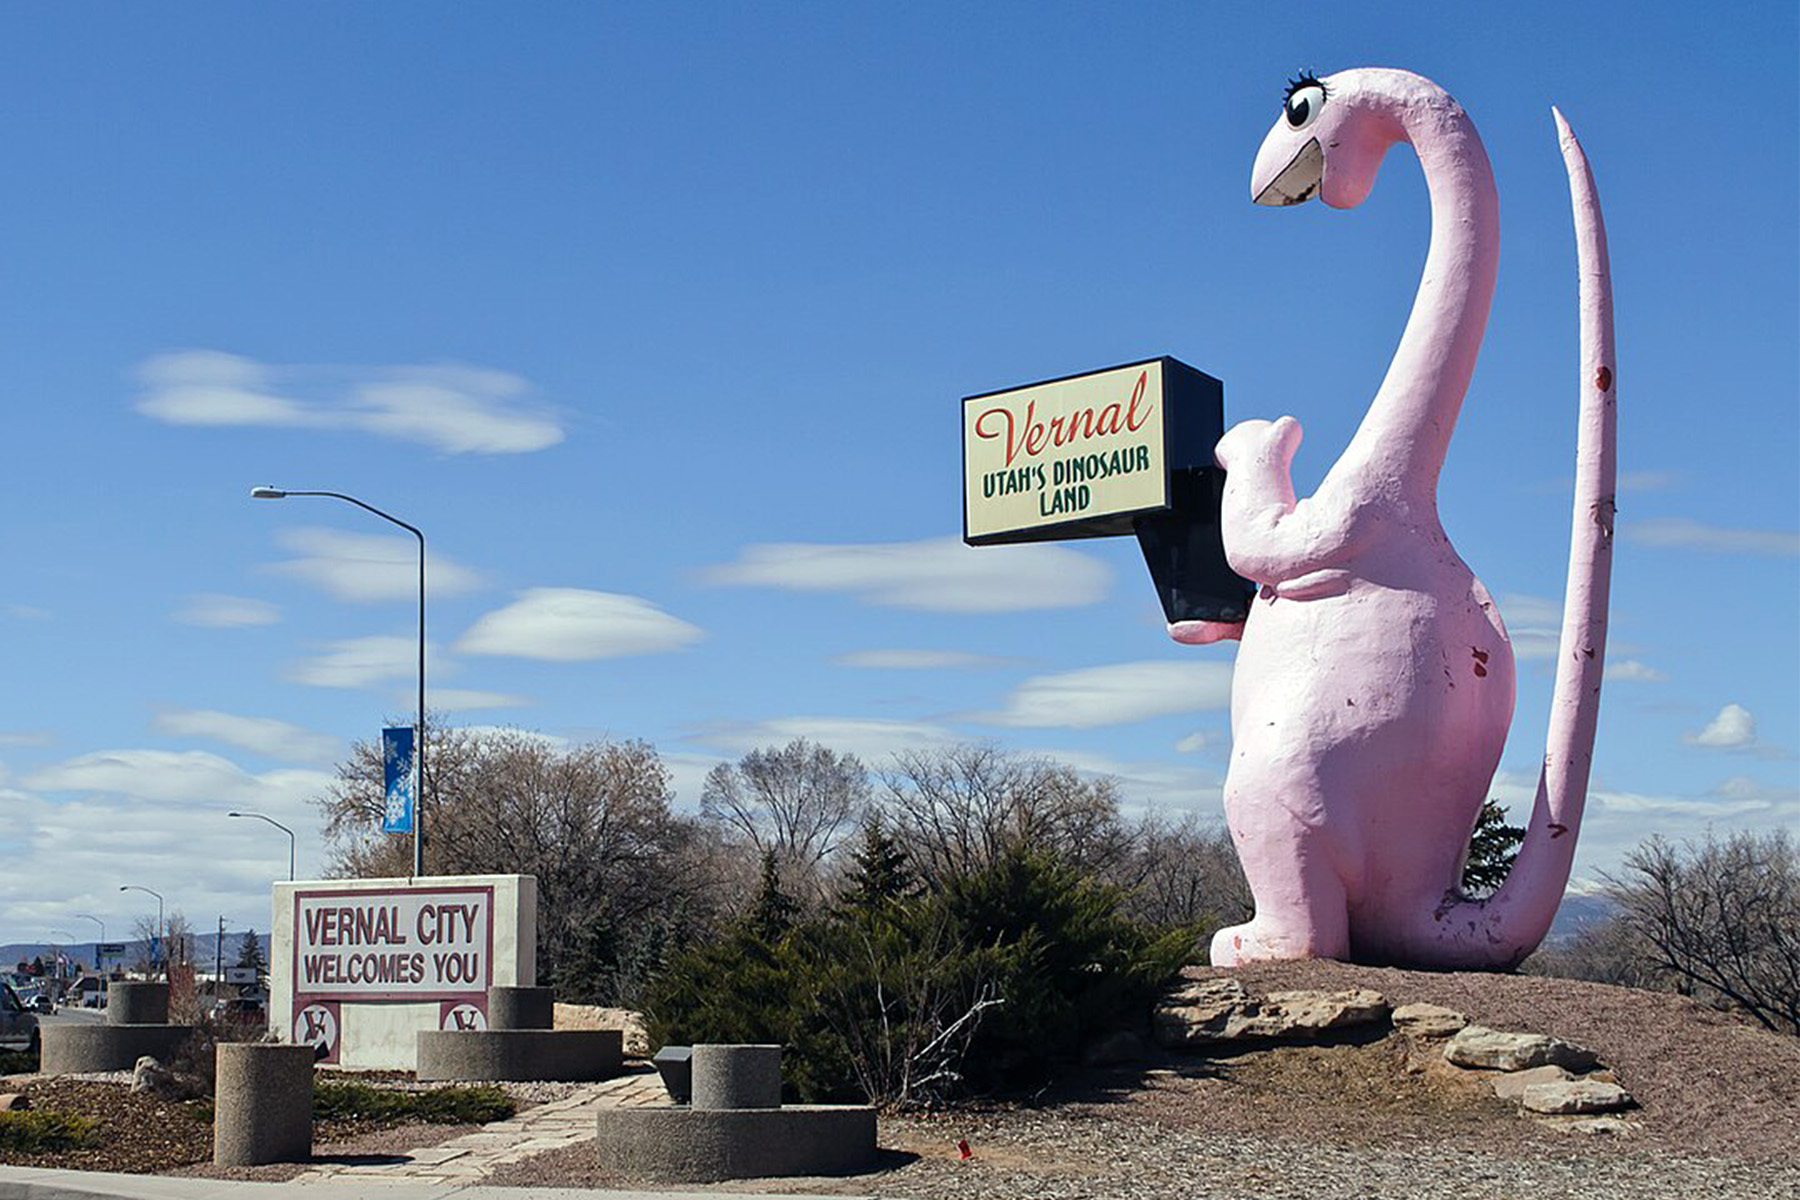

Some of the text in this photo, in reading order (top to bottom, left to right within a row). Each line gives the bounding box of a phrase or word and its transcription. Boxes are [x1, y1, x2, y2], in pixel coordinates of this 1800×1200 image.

[975, 370, 1153, 467] Vernal
[983, 445, 1149, 498] UTAH'S DINOSAUR
[1040, 485, 1090, 517] LAND
[305, 904, 479, 946] VERNAL CITY
[304, 953, 478, 984] WELCOMES YOU
